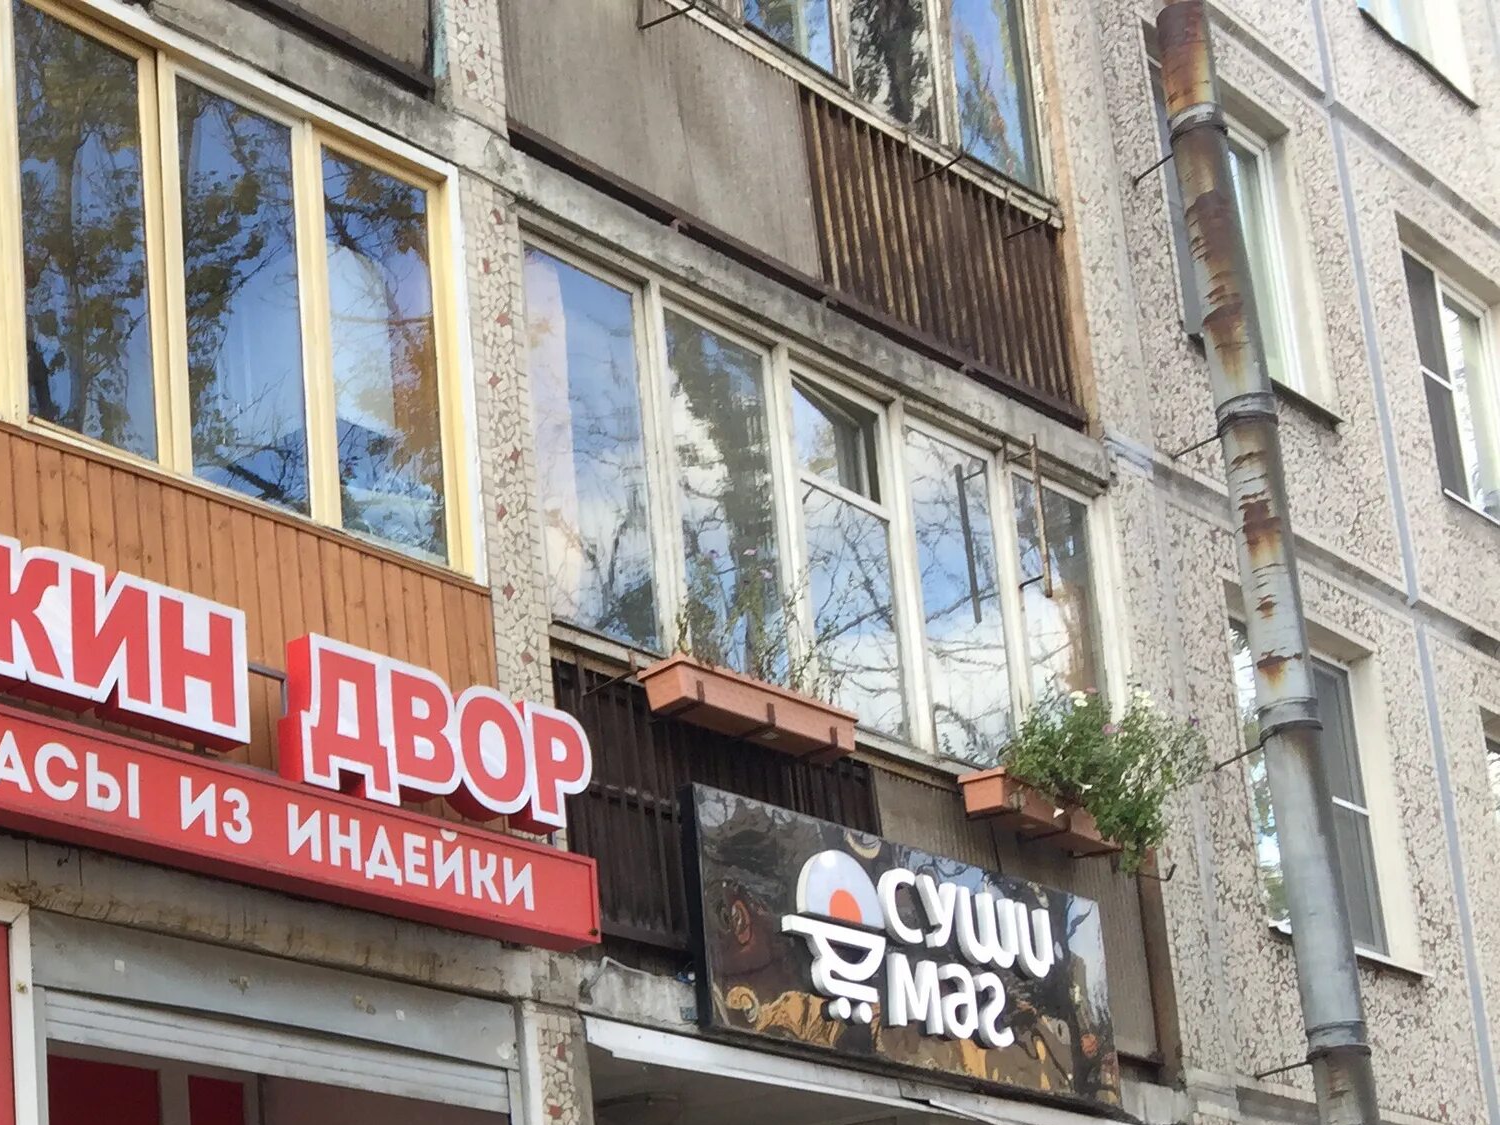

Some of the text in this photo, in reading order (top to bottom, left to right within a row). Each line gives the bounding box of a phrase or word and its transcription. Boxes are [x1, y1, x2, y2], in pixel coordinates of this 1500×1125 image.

[300, 632, 592, 829] ДВОР
[180, 776, 253, 844] ИЗ
[288, 804, 535, 911] ИНДЕЙКИ
